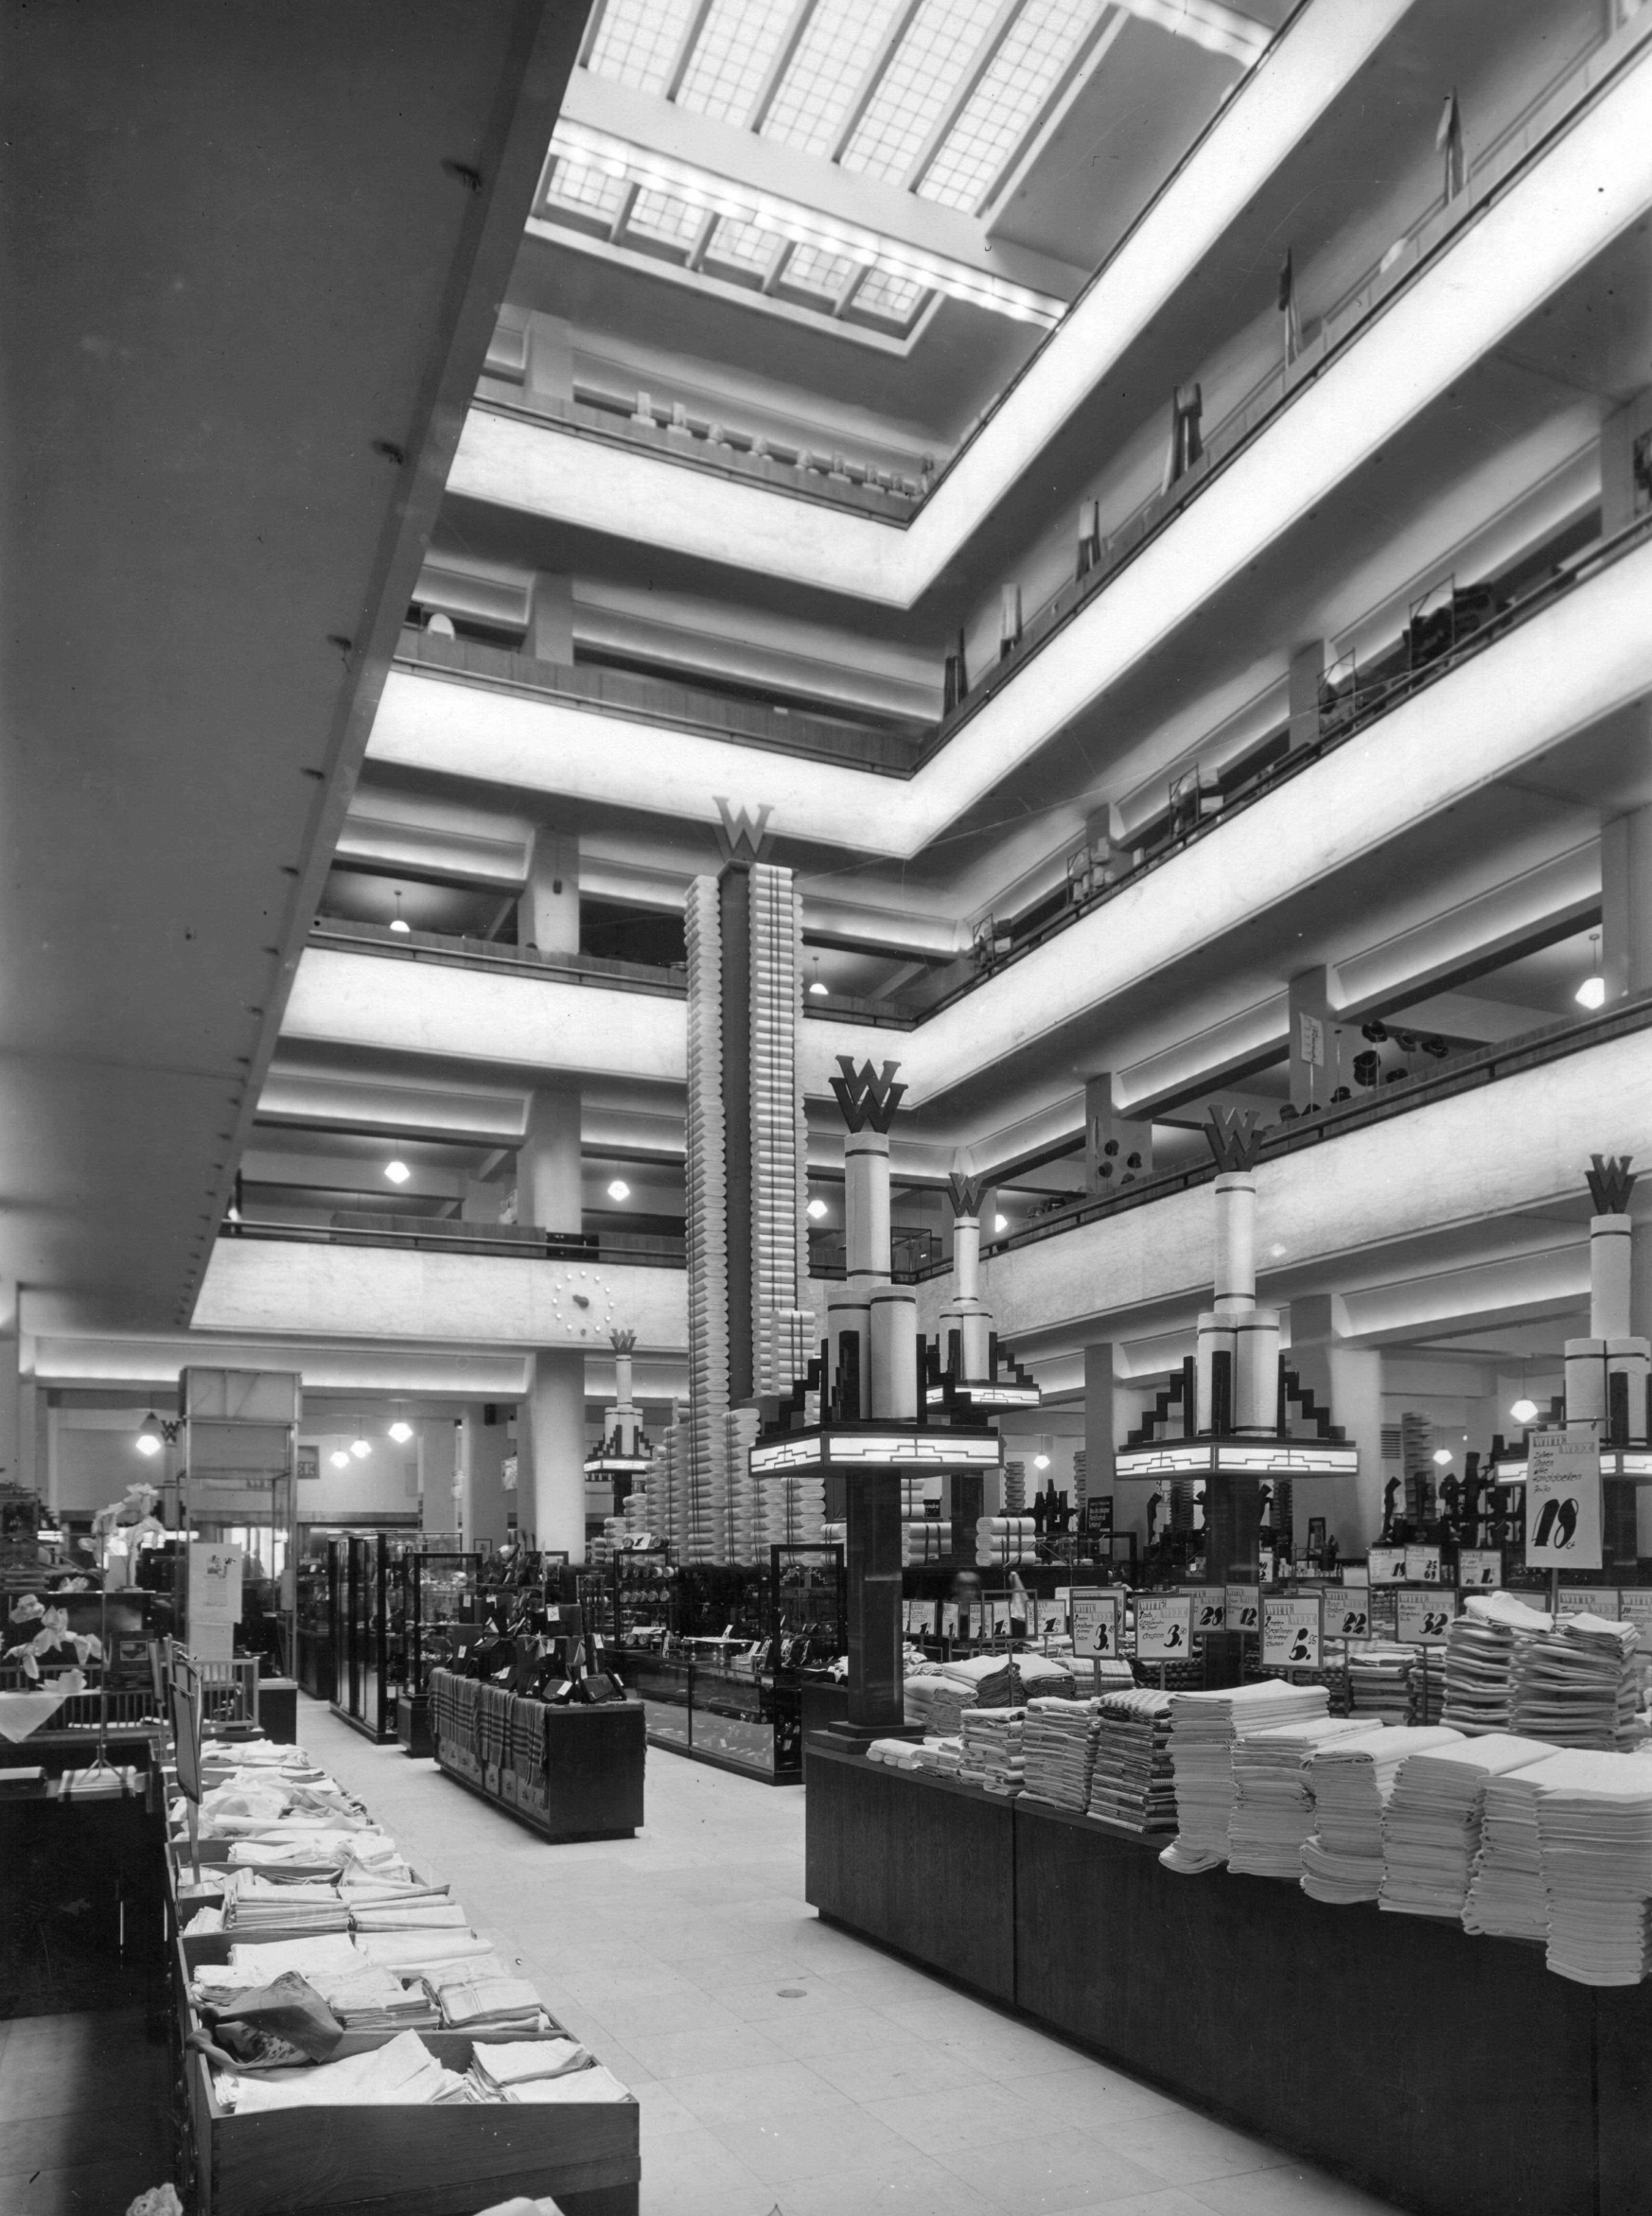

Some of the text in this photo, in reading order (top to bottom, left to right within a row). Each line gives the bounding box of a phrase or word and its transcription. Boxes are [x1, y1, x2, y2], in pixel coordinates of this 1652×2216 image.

[1535, 1434, 1567, 1447] WITTE
[1560, 1442, 1594, 1454] WEEK
[1531, 1498, 1579, 1549] 18
[1560, 1593, 1596, 1604] WITTE
[1075, 1604, 1096, 1613] WITTE
[1139, 1600, 1167, 1610] WITTE
[1266, 1604, 1293, 1615] WITTE
[1290, 1613, 1317, 1625] WEEK
[1342, 1611, 1366, 1634] 22
[1418, 1612, 1449, 1636] 32
